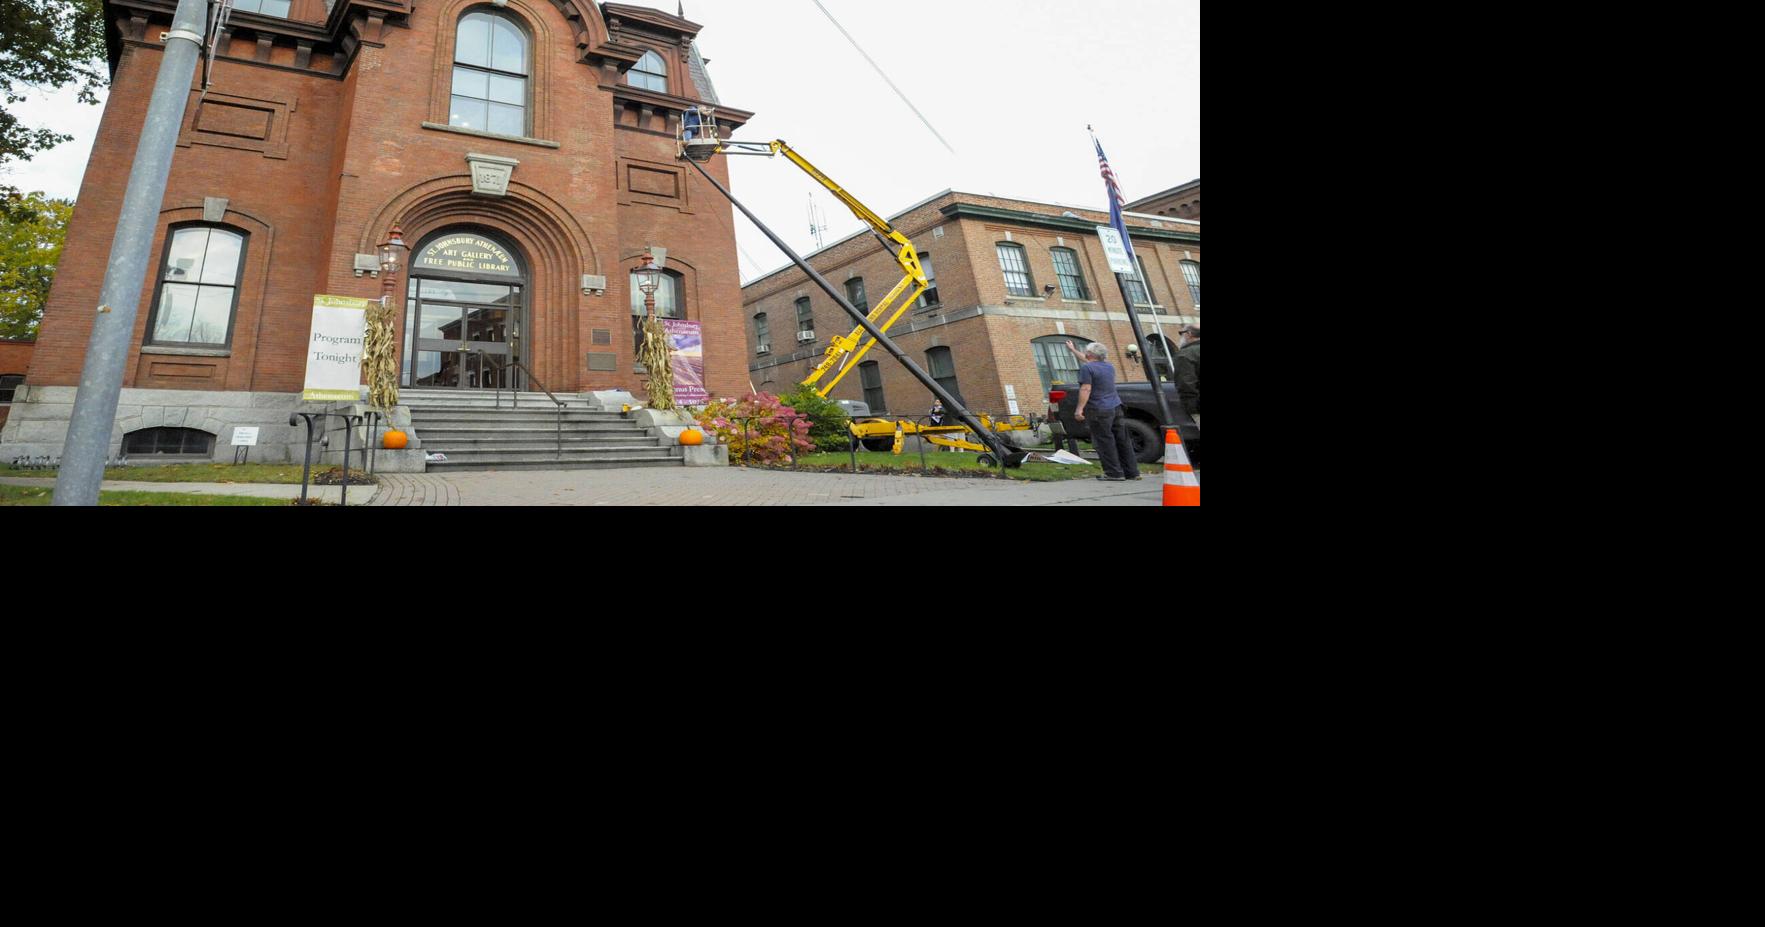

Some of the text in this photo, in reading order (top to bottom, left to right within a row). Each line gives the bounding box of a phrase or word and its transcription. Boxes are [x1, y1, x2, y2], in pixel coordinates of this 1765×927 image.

[435, 237, 475, 250] JOHNSBURY
[443, 249, 494, 260] ART GALLERY
[424, 257, 510, 271] FREE PUBLIC LIBRARY
[314, 332, 363, 345] Program
[313, 351, 358, 364] Tonight
